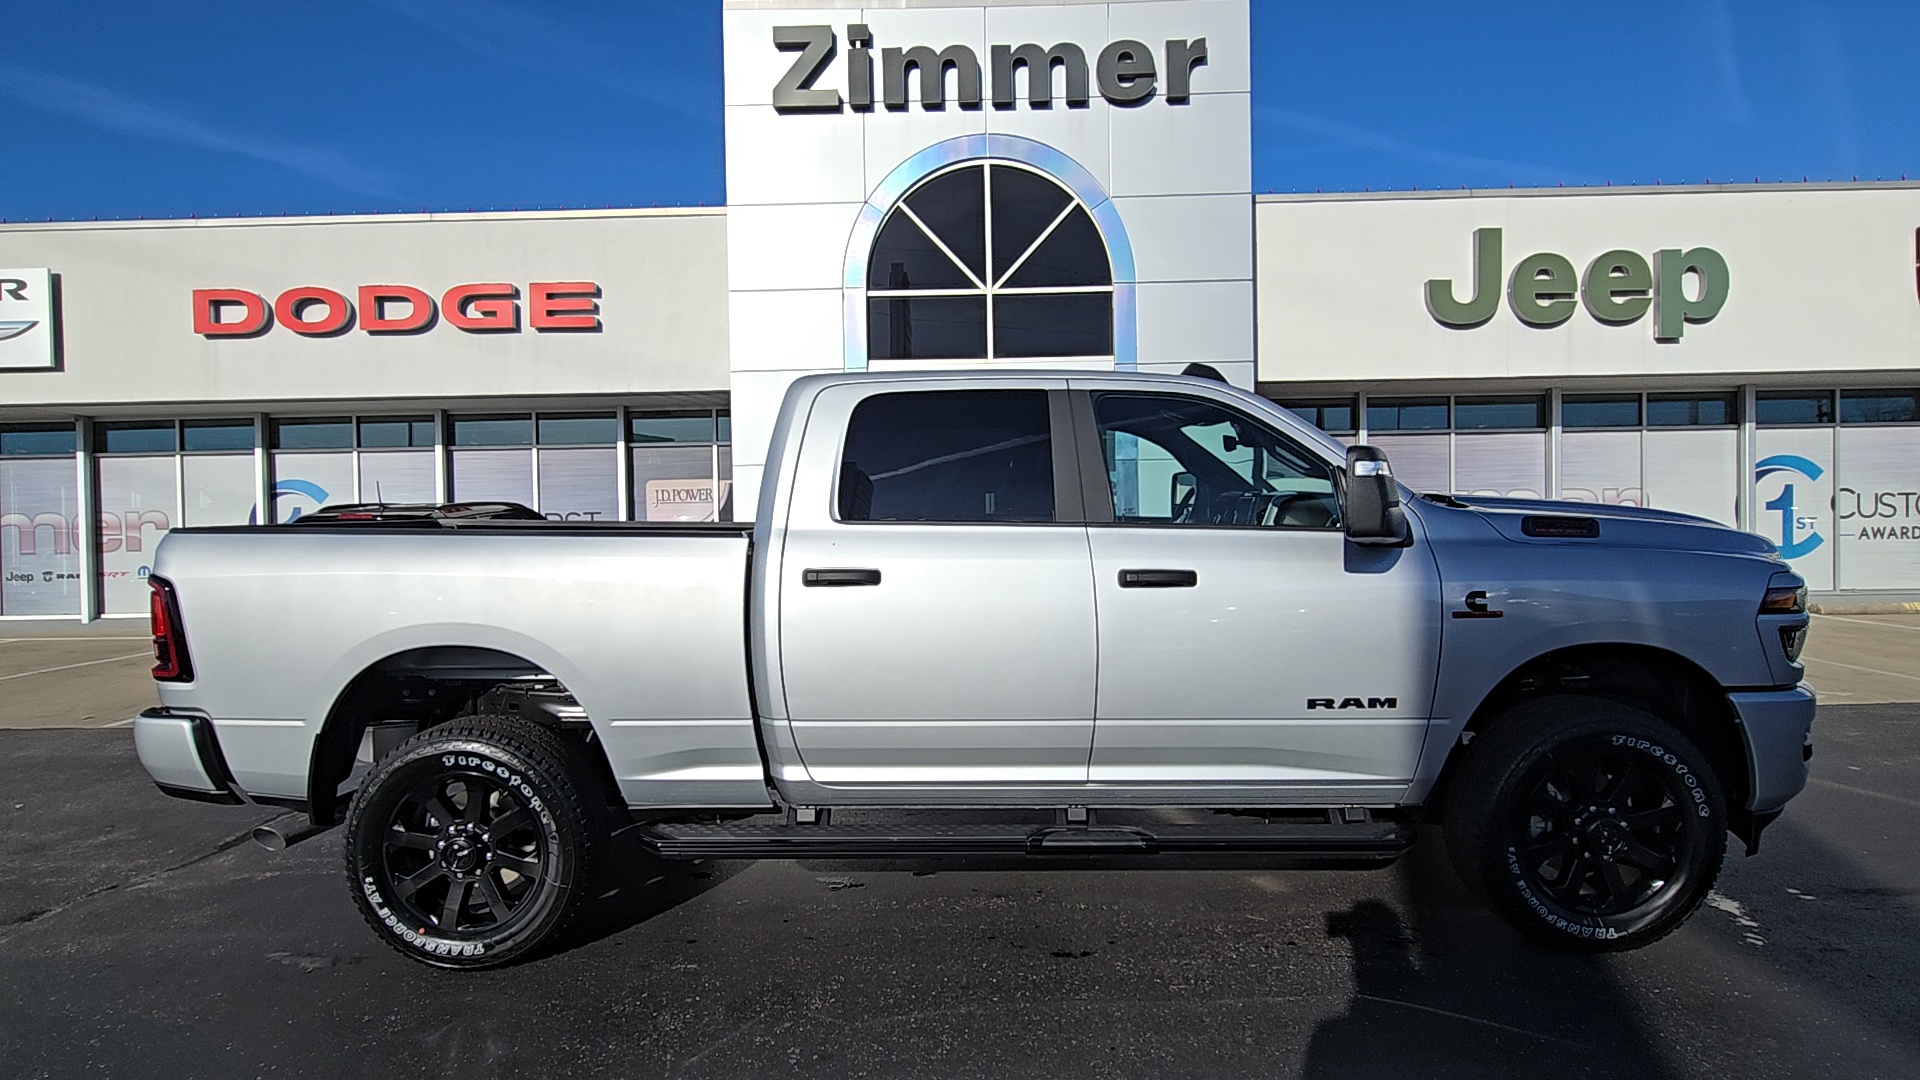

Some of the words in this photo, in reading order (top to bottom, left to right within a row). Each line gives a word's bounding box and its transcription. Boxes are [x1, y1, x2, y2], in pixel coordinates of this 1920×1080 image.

[773, 24, 1207, 115] Zimmer
[1424, 227, 1730, 343] Jeep
[193, 282, 602, 337] DODGE
[673, 488, 713, 502] POWER
[1831, 488, 1920, 519] CUST
[5, 572, 34, 583] Jeep
[1307, 697, 1398, 710] RAM
